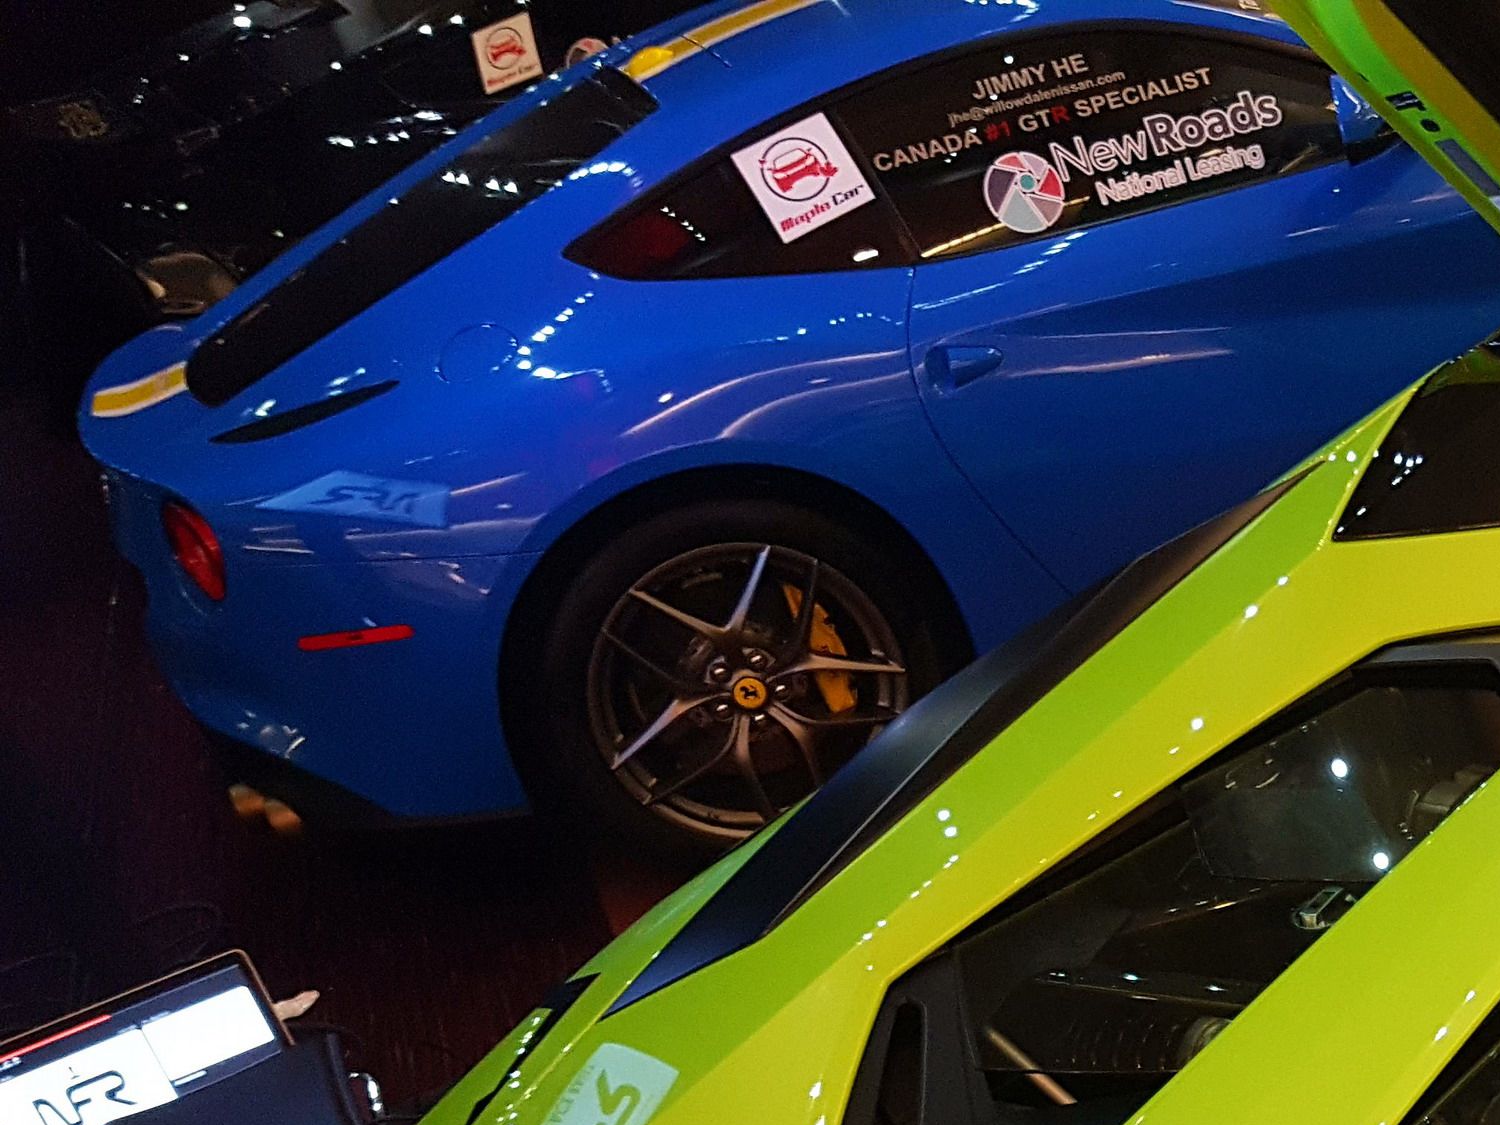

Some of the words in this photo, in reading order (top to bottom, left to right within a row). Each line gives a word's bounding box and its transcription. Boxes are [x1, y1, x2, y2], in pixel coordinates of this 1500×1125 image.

[972, 63, 1045, 100] JIMMY
[1051, 53, 1090, 78] HE
[873, 130, 982, 171] CANADA
[1018, 105, 1071, 132] GTR
[1073, 66, 1213, 118] SPECIALIST
[1094, 157, 1187, 206] National
[1184, 144, 1266, 181] Leasing
[780, 201, 831, 232] Maple
[832, 184, 864, 206] Car
